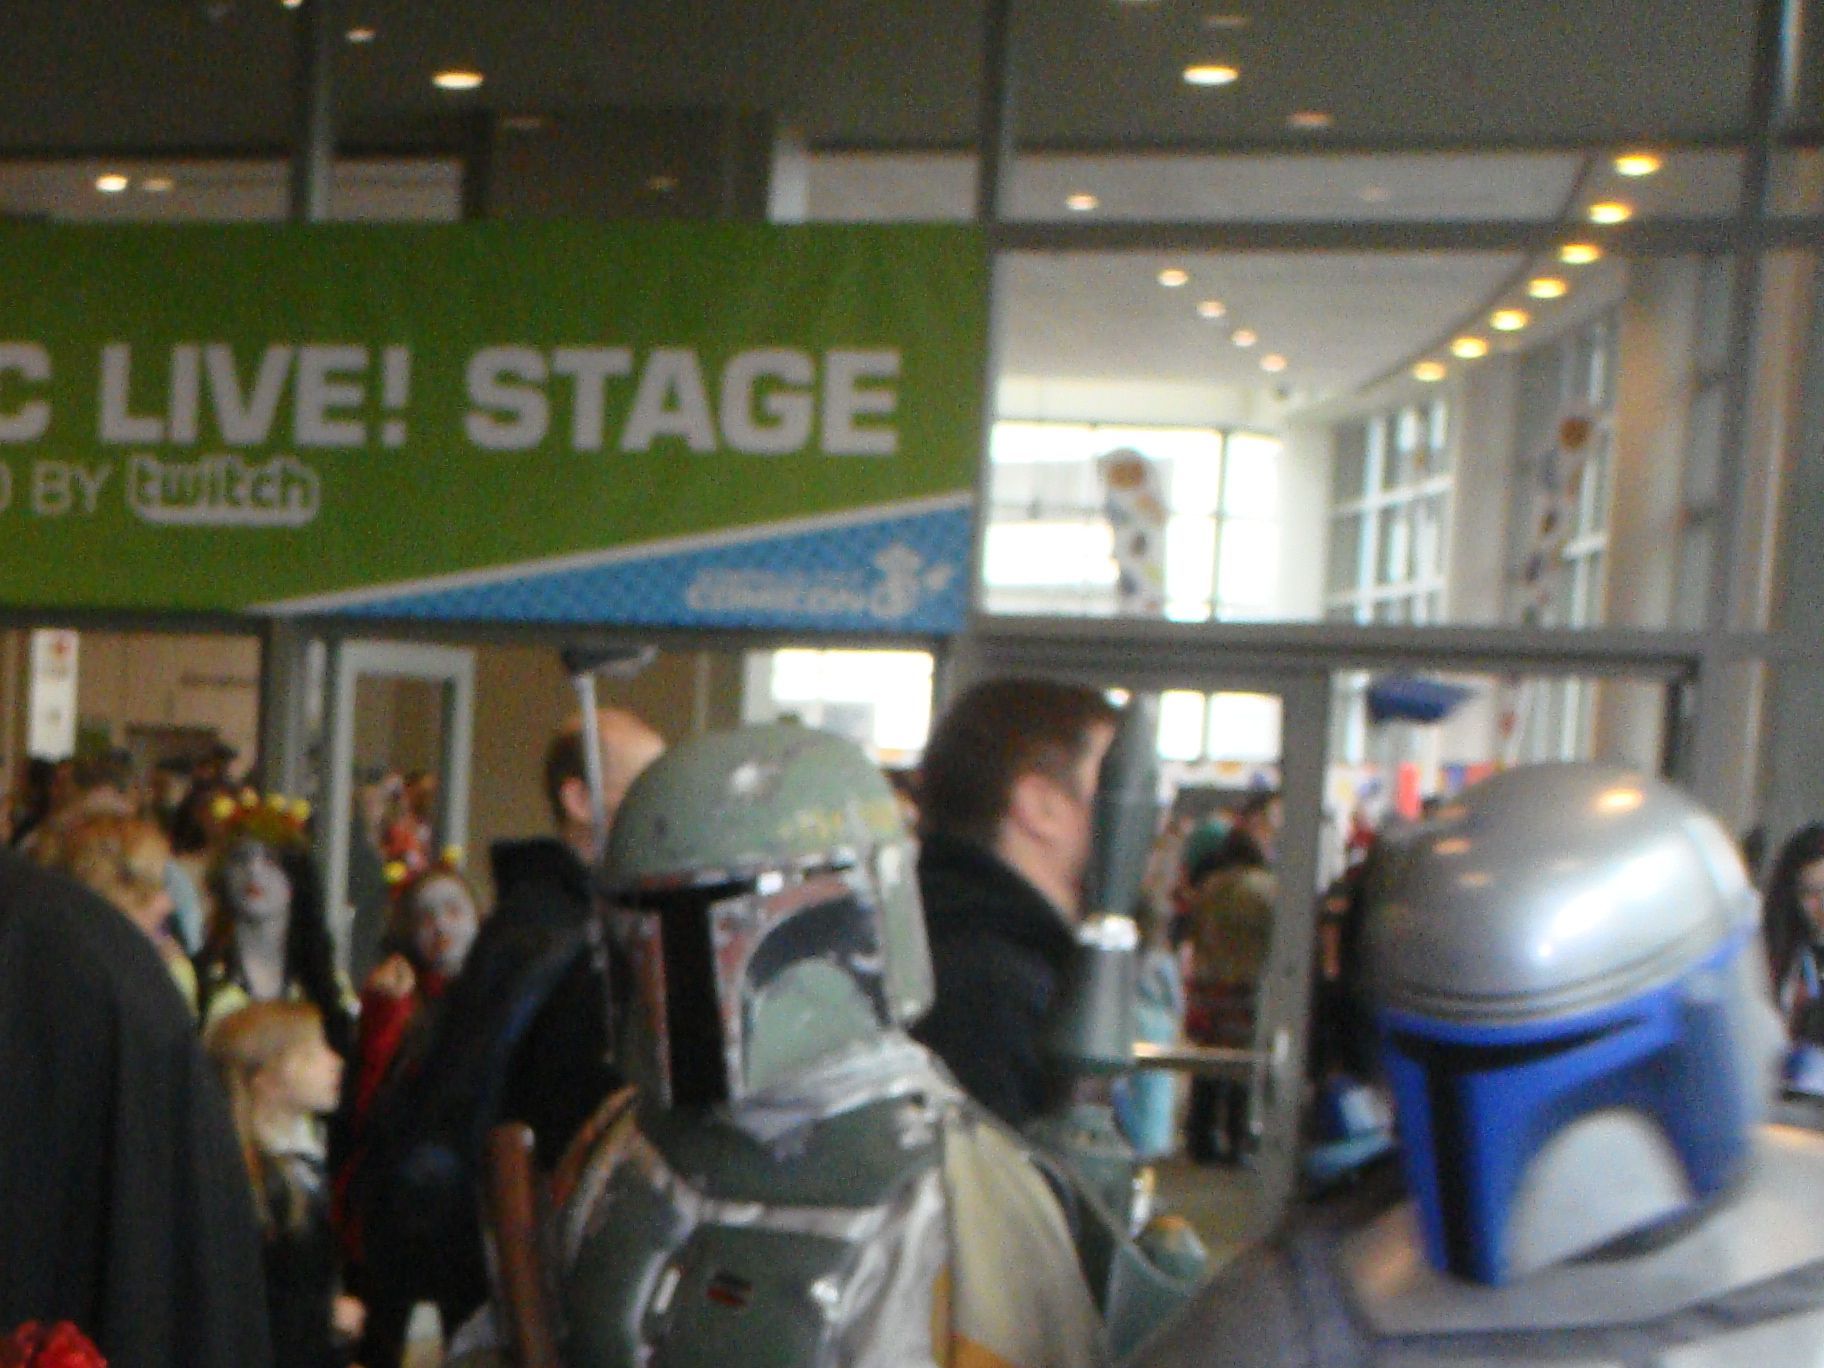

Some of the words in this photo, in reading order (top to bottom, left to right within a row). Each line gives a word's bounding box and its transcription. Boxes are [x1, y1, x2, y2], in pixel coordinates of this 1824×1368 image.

[99, 342, 413, 447] LIVE!
[463, 344, 901, 454] STAGE
[31, 458, 113, 517] BY
